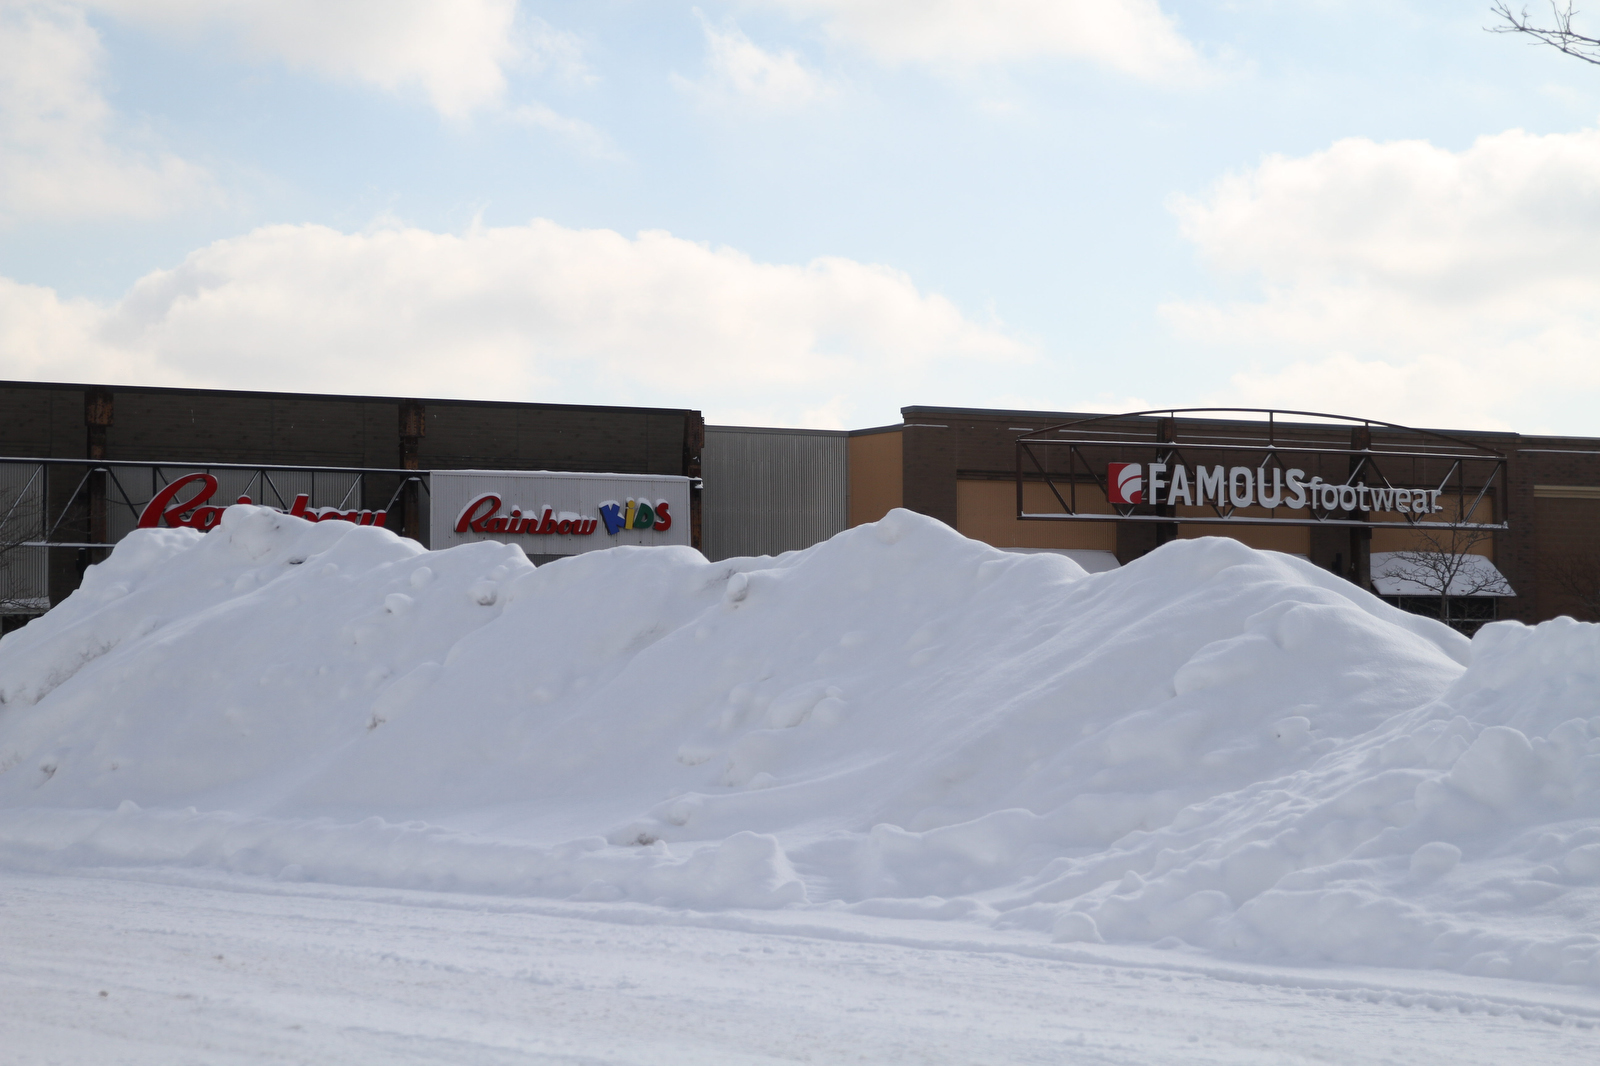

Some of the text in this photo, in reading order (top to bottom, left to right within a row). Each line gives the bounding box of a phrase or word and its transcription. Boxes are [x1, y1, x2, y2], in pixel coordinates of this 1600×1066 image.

[1148, 463, 1442, 513] FAMOUS footwear
[454, 493, 598, 536] Rainbow
